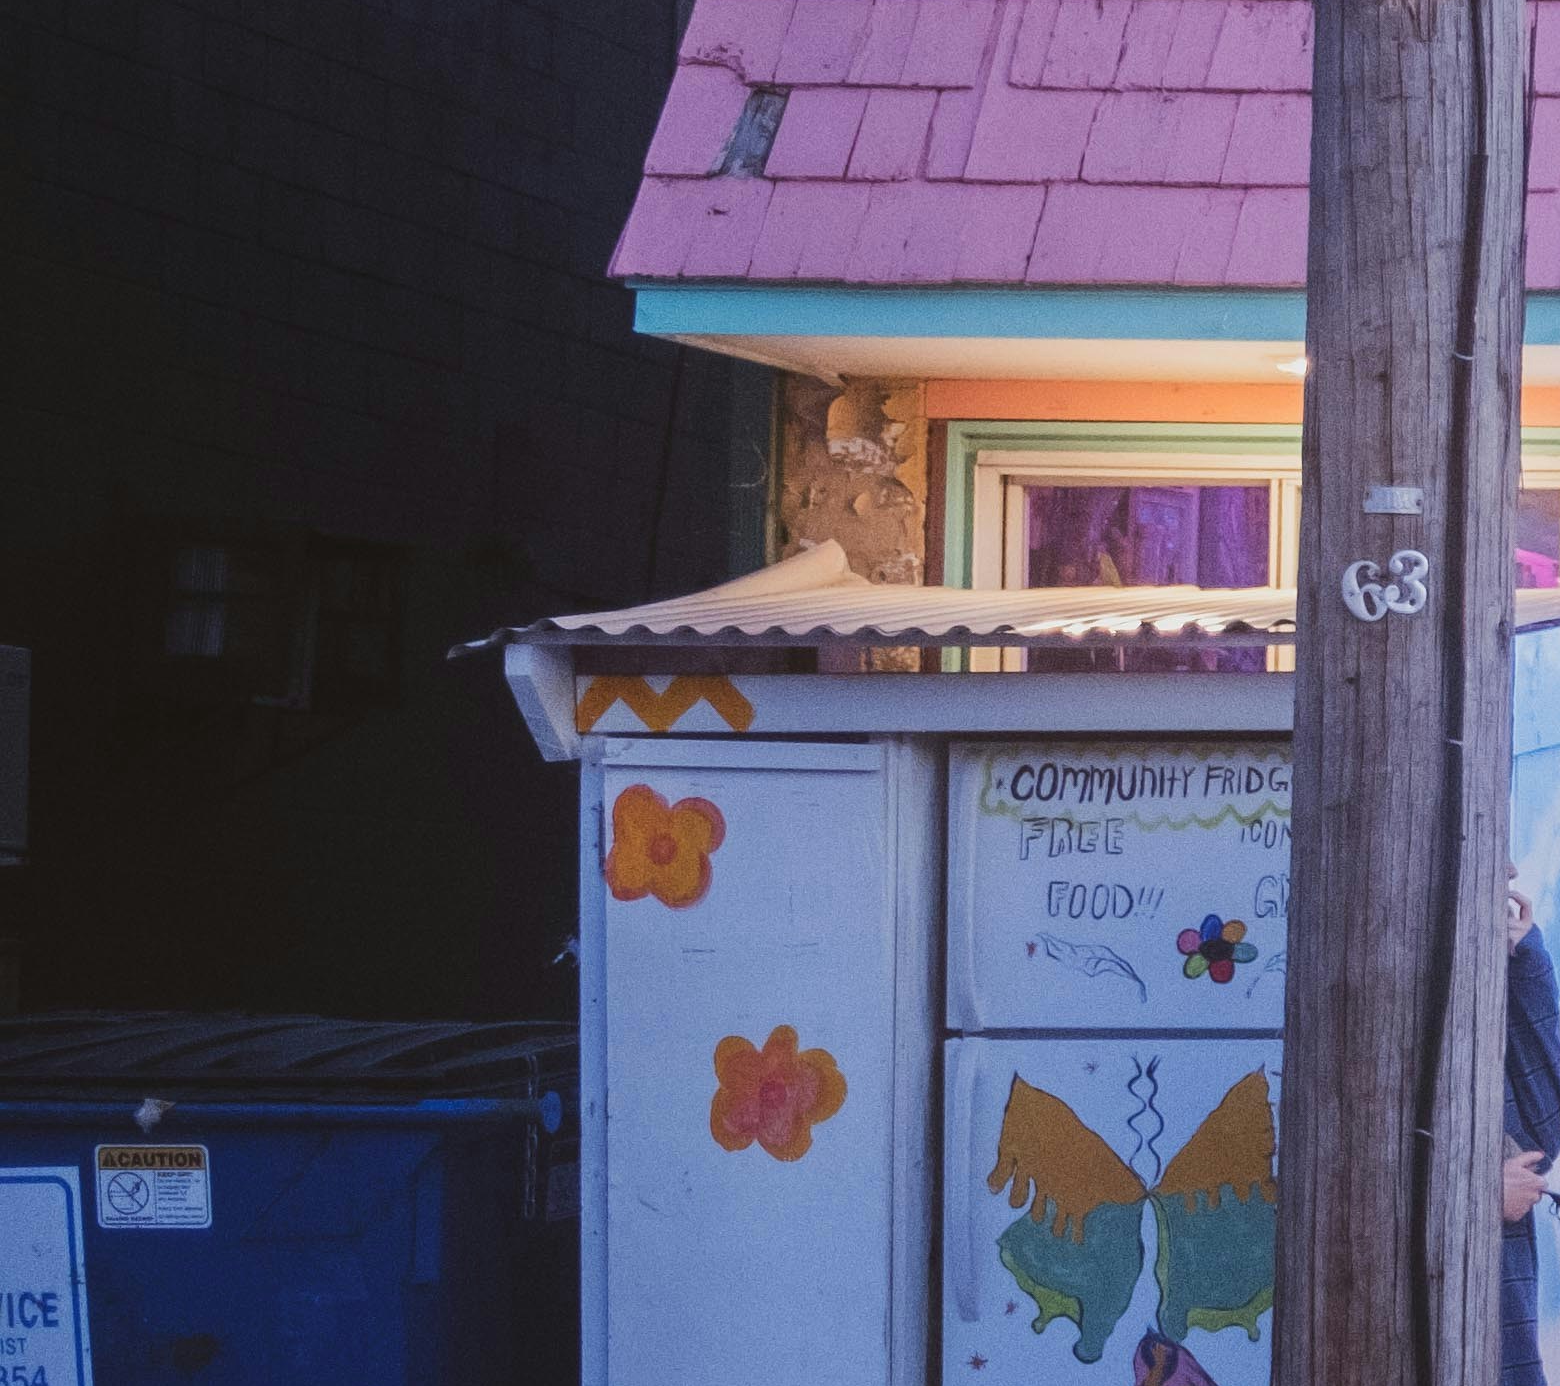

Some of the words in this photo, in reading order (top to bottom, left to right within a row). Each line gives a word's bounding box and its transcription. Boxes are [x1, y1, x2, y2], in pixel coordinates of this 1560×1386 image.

[1341, 549, 1429, 622] 63
[1010, 763, 1195, 805] COMMUNITY
[1203, 765, 1289, 797] FRIDG
[1019, 816, 1124, 860] FREE
[1048, 881, 1164, 920] FOOD!!!
[118, 1152, 201, 1168] CAUTION
[0, 1292, 60, 1329] ICE
